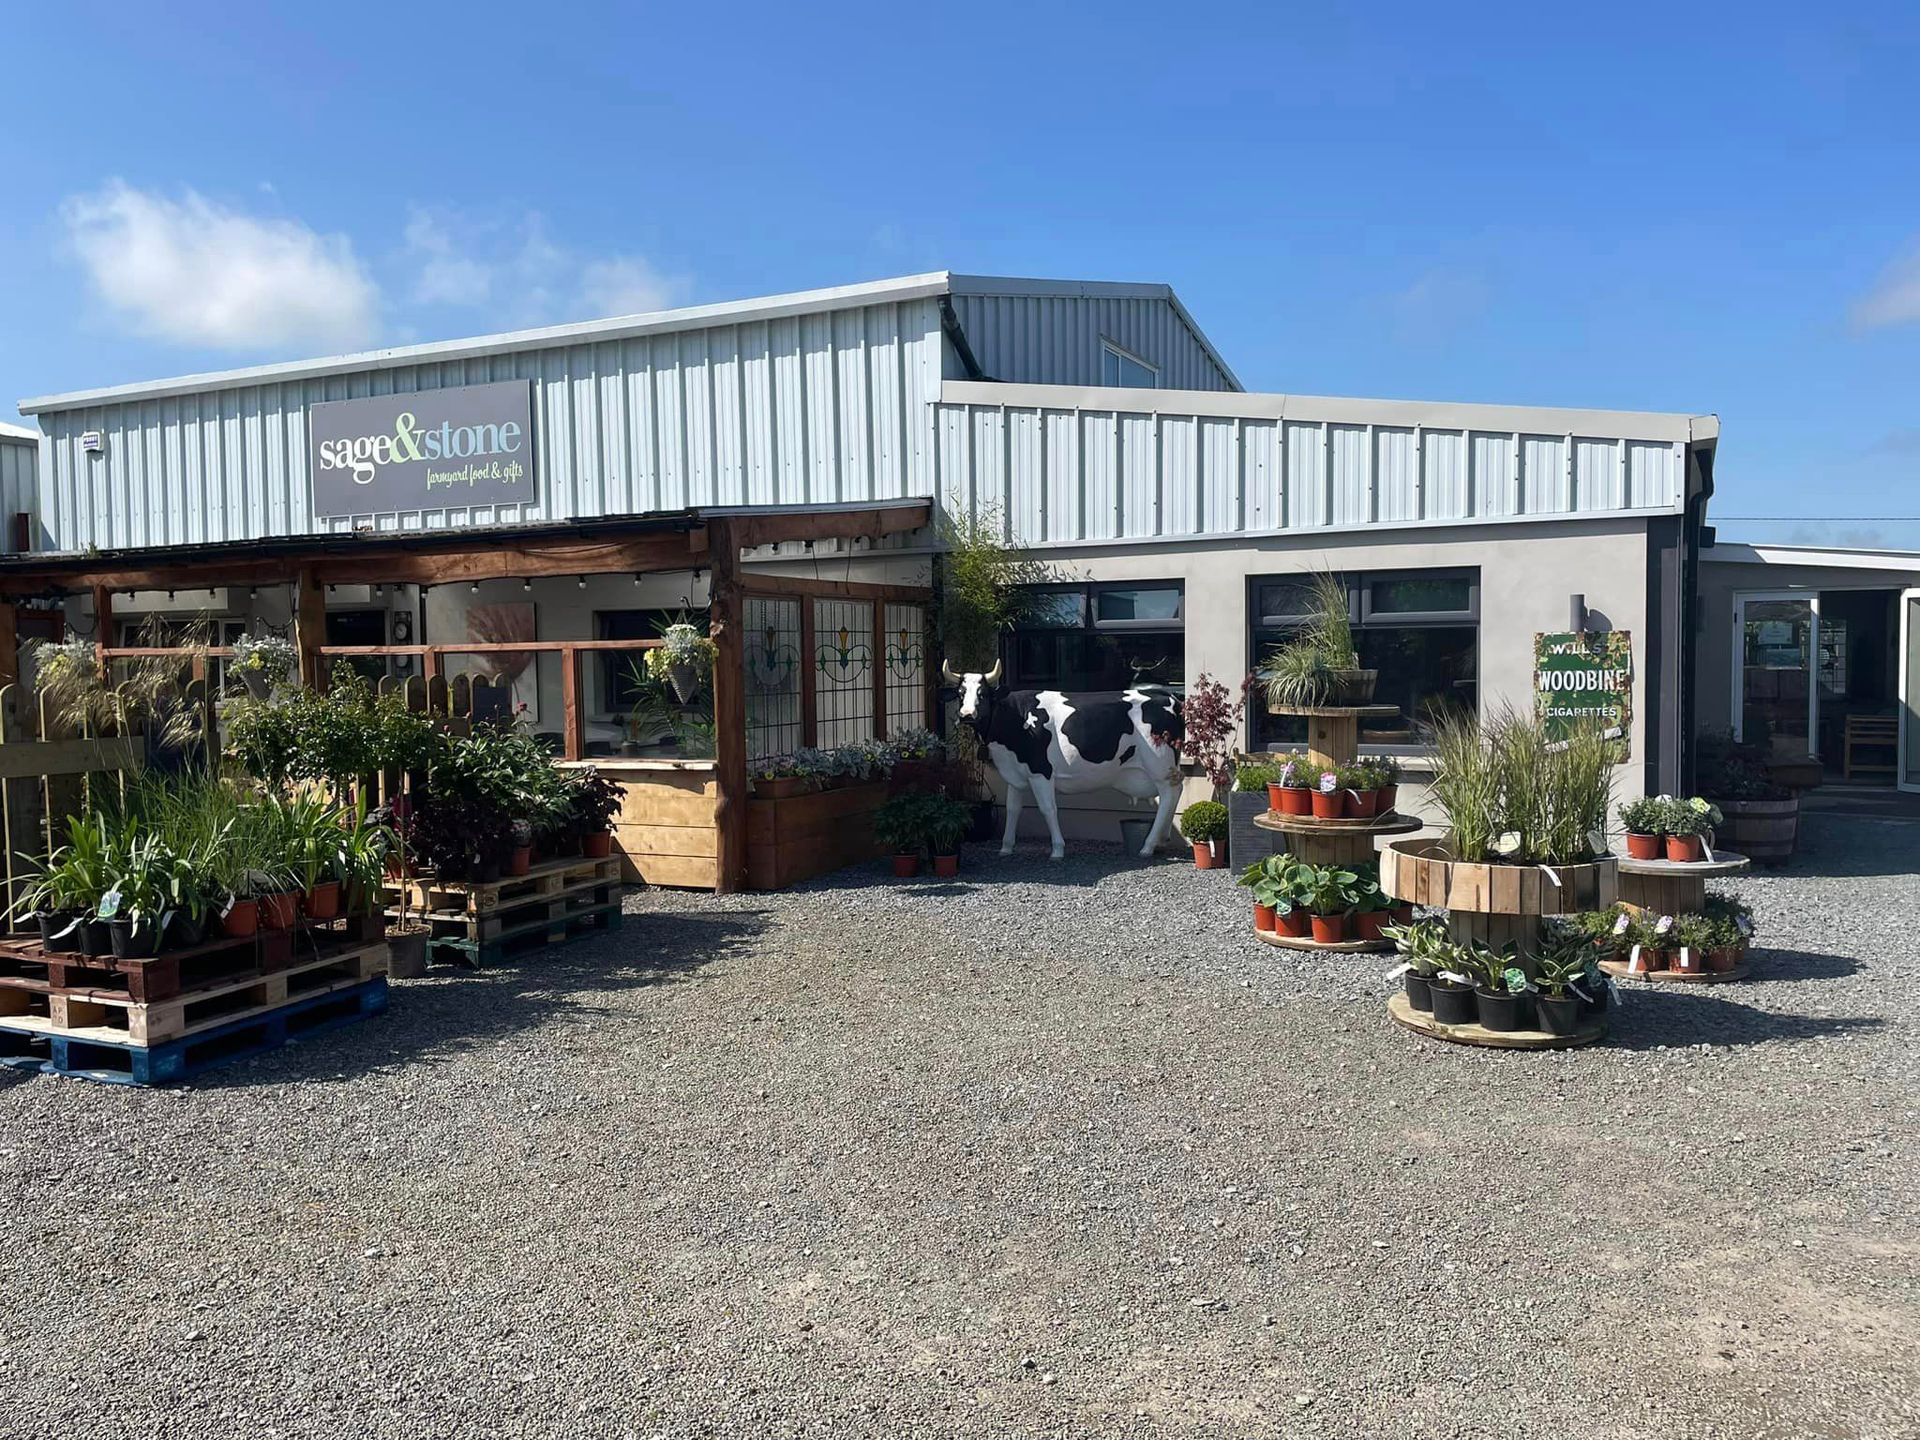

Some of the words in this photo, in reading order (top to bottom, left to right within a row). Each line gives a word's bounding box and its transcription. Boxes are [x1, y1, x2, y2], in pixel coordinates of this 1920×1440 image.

[320, 412, 521, 485] sage&stone
[427, 467, 468, 490] farmyard
[469, 463, 489, 487] food
[491, 461, 502, 479] &
[503, 460, 523, 483] gifts
[1540, 669, 1625, 691] WOODBINE
[1547, 707, 1617, 717] CIGARETTES
